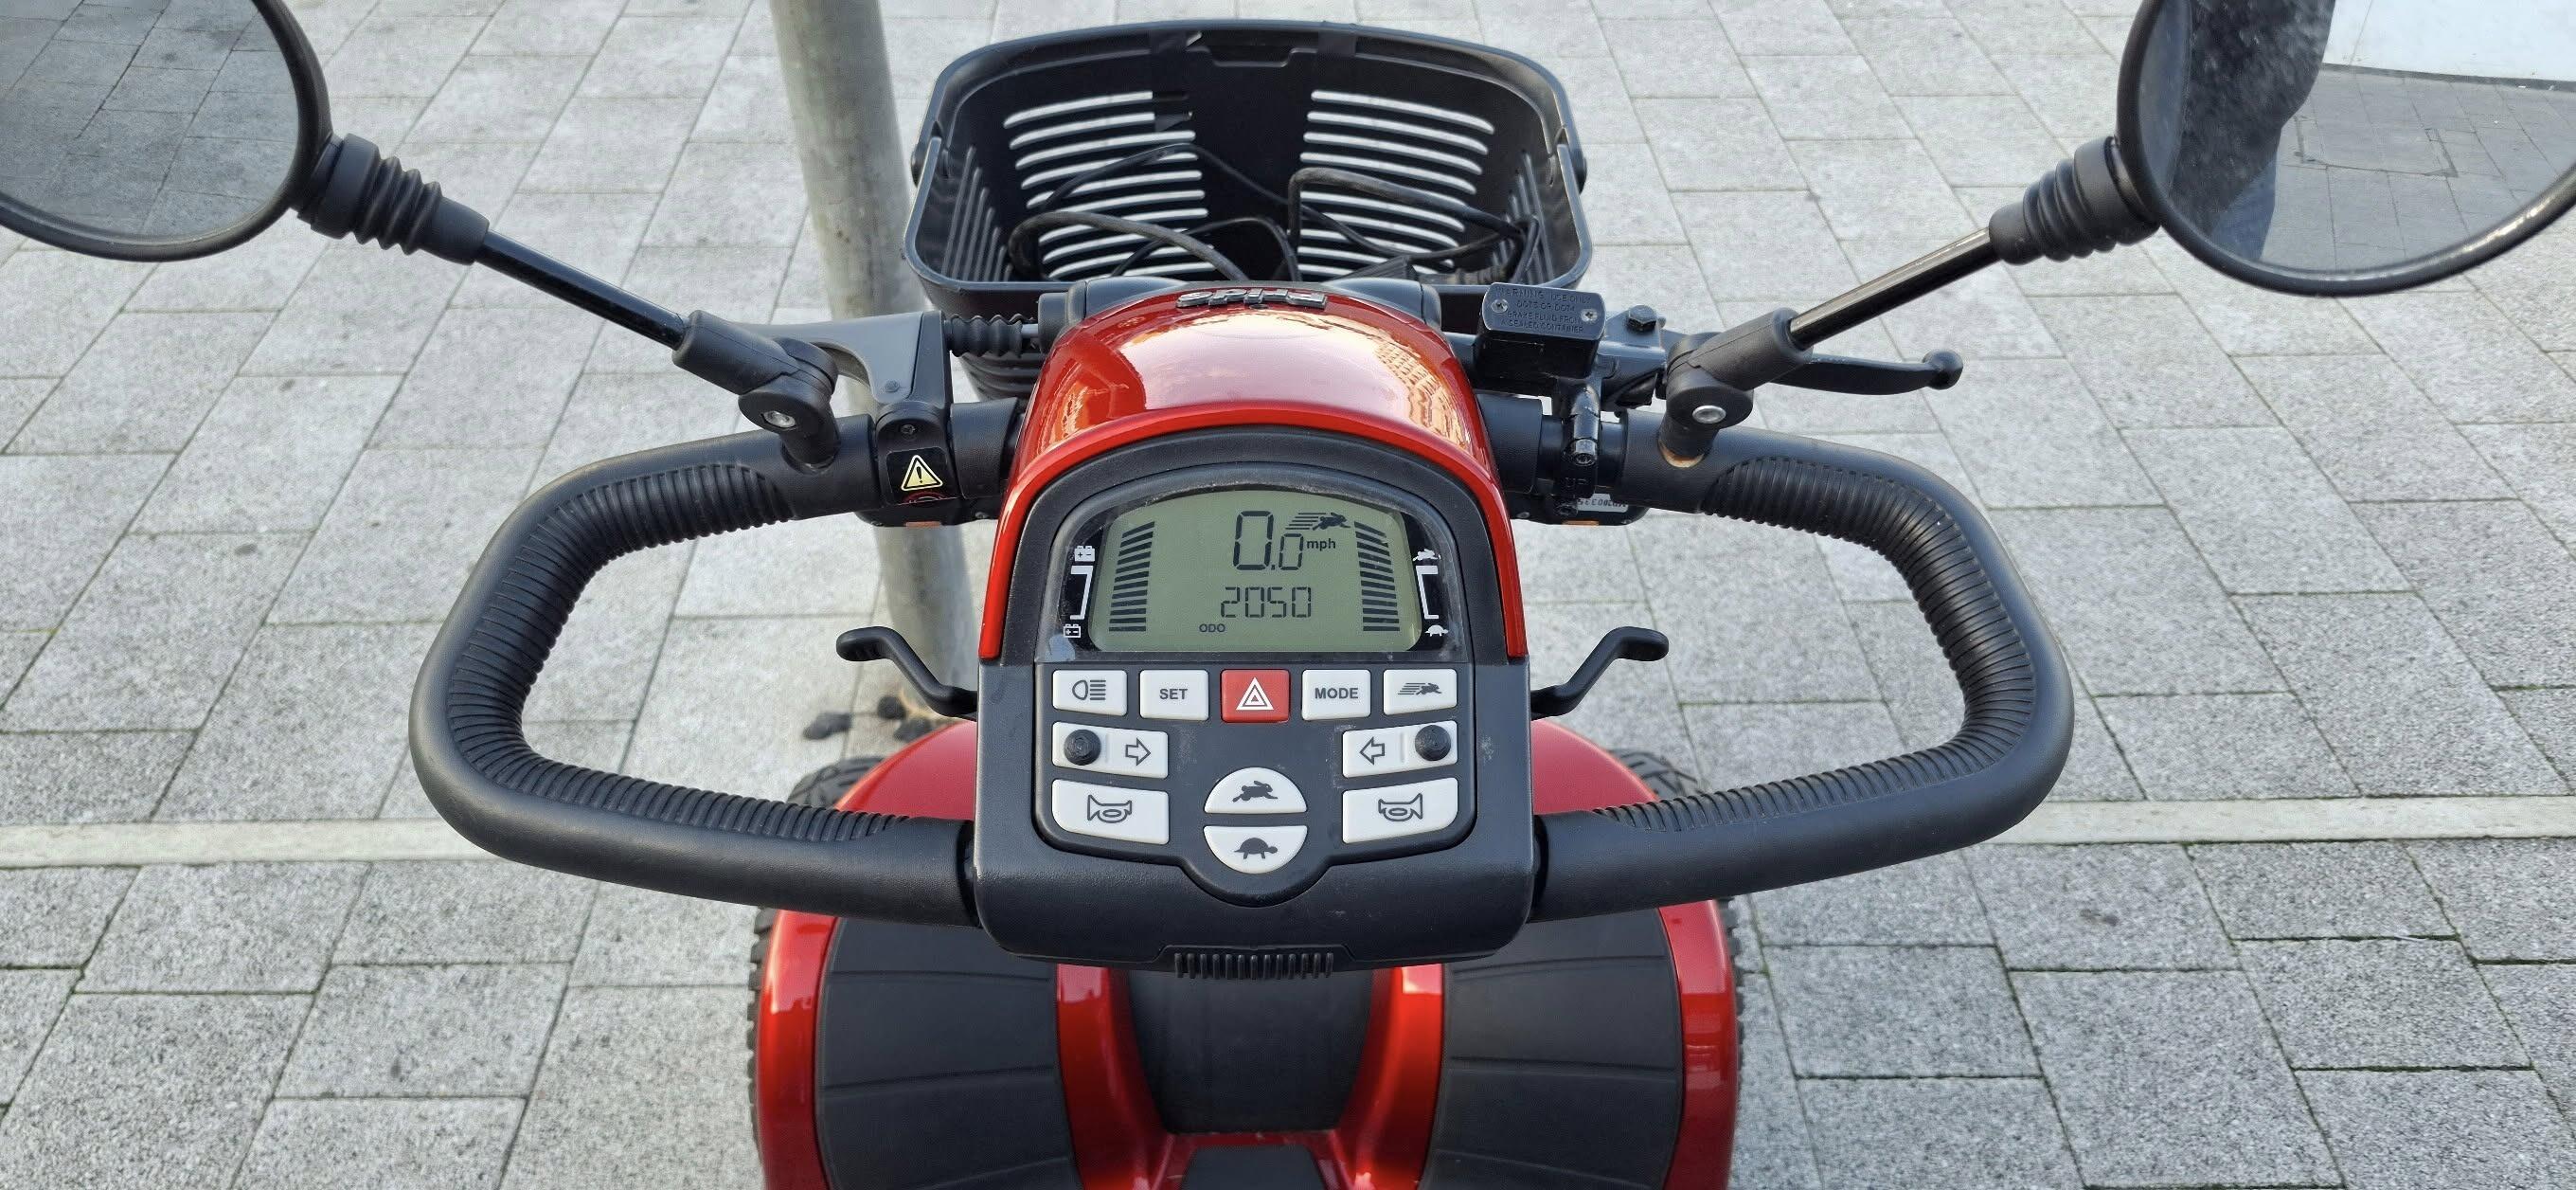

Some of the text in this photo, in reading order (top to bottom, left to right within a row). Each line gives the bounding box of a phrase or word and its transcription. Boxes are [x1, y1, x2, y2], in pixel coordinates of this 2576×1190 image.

[1550, 293, 1567, 301] USE
[1540, 302, 1551, 311] OR
[1507, 311, 1532, 320] BRAKE
[1534, 313, 1558, 322] FLUID
[1232, 511, 1336, 570] 0.0 mph
[1220, 586, 1312, 618] 2050
[1198, 623, 1225, 633] ODO
[1159, 688, 1188, 700] SET
[1315, 687, 1359, 700] MODE
